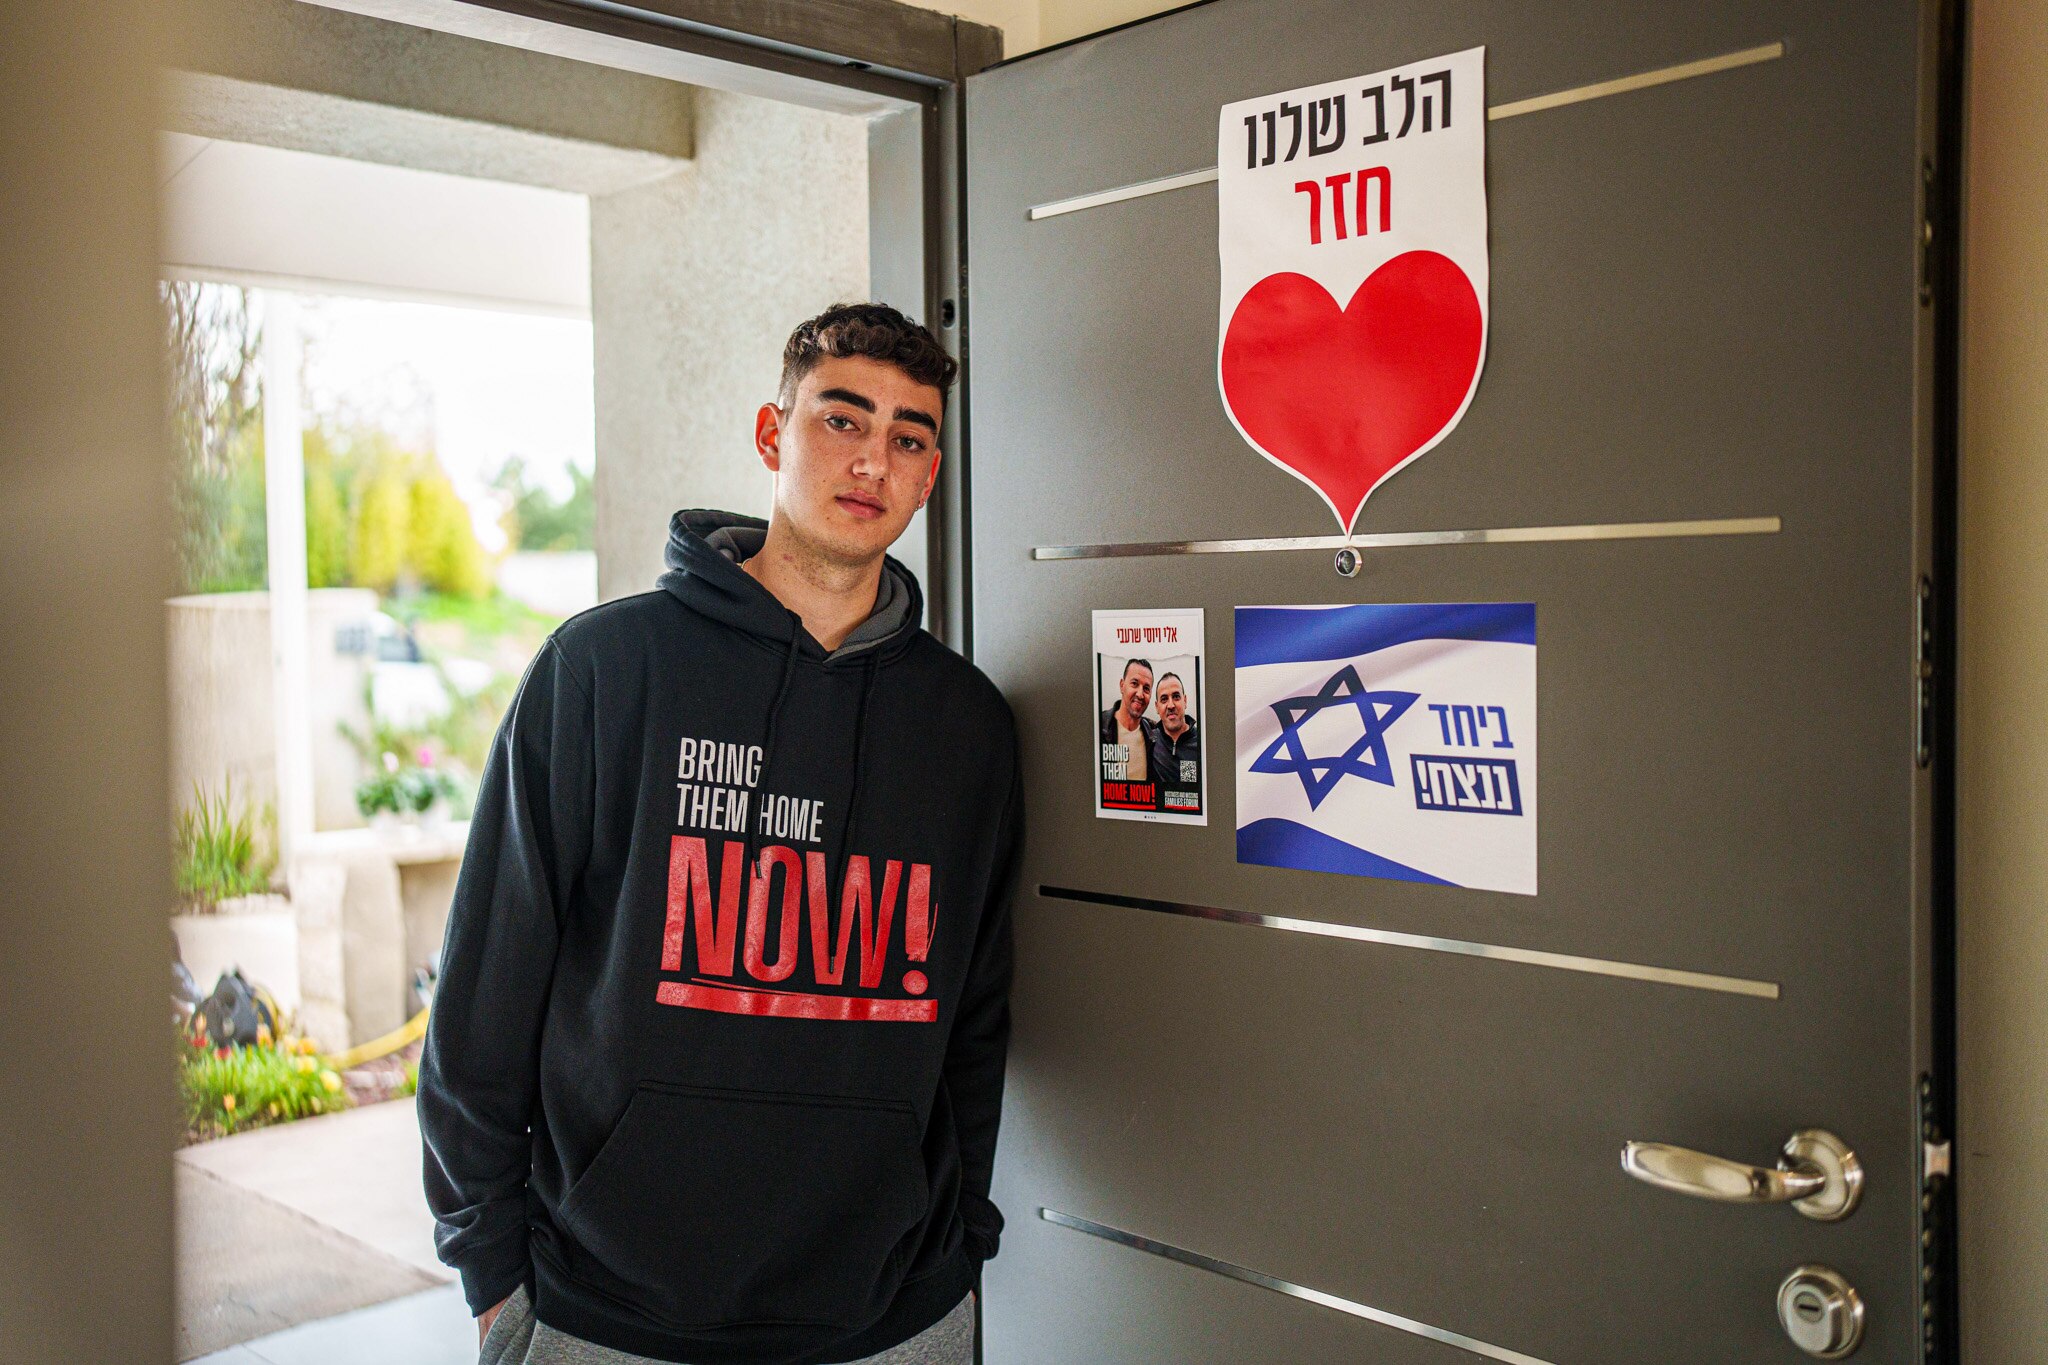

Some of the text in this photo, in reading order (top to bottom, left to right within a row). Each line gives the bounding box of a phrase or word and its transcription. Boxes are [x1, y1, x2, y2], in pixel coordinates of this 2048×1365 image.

[1244, 69, 1451, 169] הלב שלנו
[1294, 166, 1391, 245] חזר
[1116, 626, 1178, 643] אלי ויוסי שרעבי
[1428, 703, 1514, 749] ביחד
[677, 737, 763, 788] BRING
[1102, 743, 1129, 762] BRING
[1102, 762, 1127, 780] THEM
[1103, 783, 1128, 801] HOME
[1129, 783, 1155, 803] NOW!
[1415, 760, 1514, 811] ננצח!
[677, 783, 824, 843] THEM HOME
[660, 835, 938, 995] NOW!
